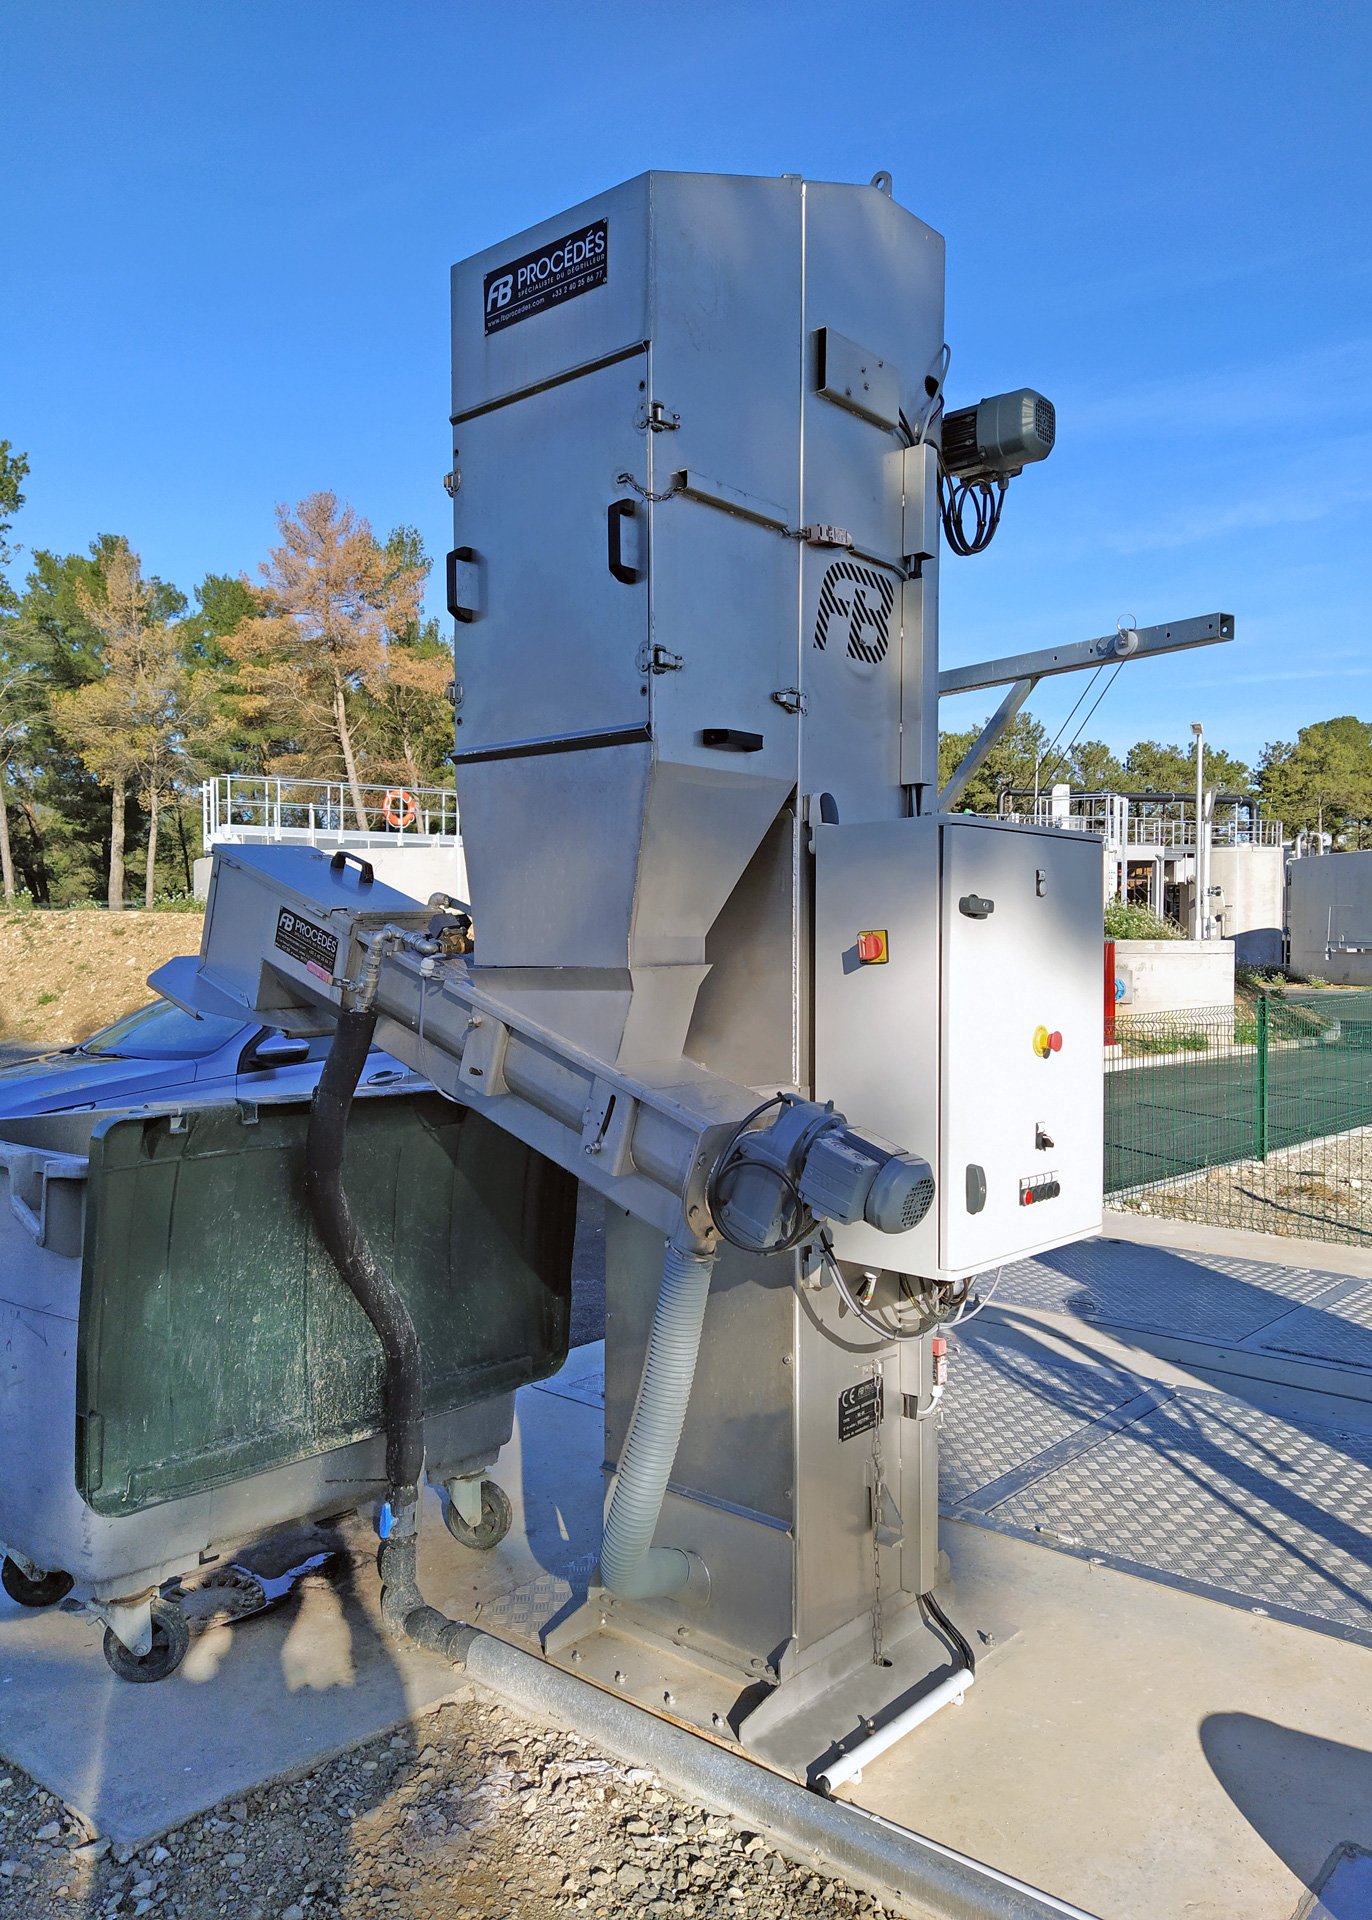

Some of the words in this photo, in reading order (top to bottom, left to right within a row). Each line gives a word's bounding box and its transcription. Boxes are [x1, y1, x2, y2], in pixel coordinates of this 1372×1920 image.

[486, 274, 513, 313] FB
[517, 229, 605, 290] PROCÉDÉS
[517, 277, 554, 298] SPÉCIALISTE
[556, 270, 565, 281] DU
[567, 253, 605, 276] DÉGRILLEUR
[487, 297, 545, 328] www.fbprocedes.com
[551, 288, 562, 299] +33
[577, 277, 585, 288] 25
[595, 270, 603, 280] 77
[813, 562, 894, 664] FB
[279, 912, 294, 932] FB
[295, 920, 337, 953] PROCÉDÉS
[842, 1387, 856, 1408] CE
